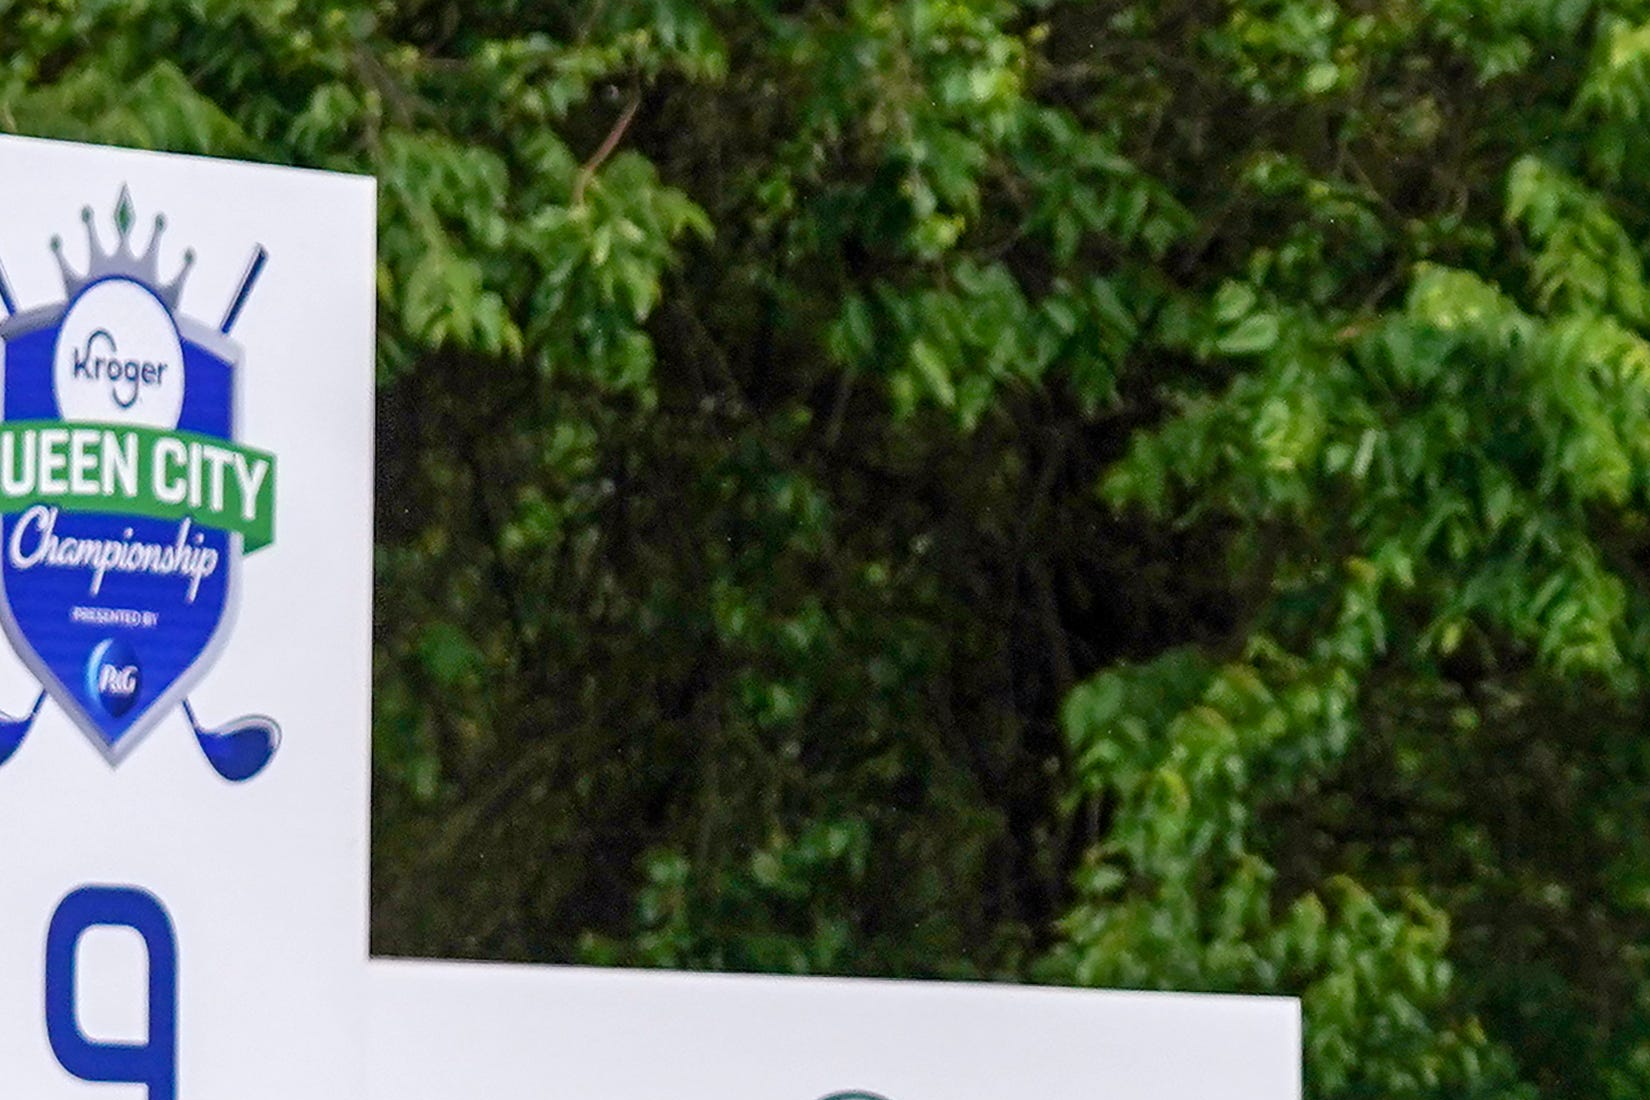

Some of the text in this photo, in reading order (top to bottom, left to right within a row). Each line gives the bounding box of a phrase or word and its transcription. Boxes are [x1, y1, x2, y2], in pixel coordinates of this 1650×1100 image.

[73, 330, 168, 408] Kroger
[0, 428, 270, 521] UEEN CITY
[10, 504, 219, 602] Championship
[71, 606, 159, 627] PRESENTED BY
[99, 663, 138, 693] P&G
